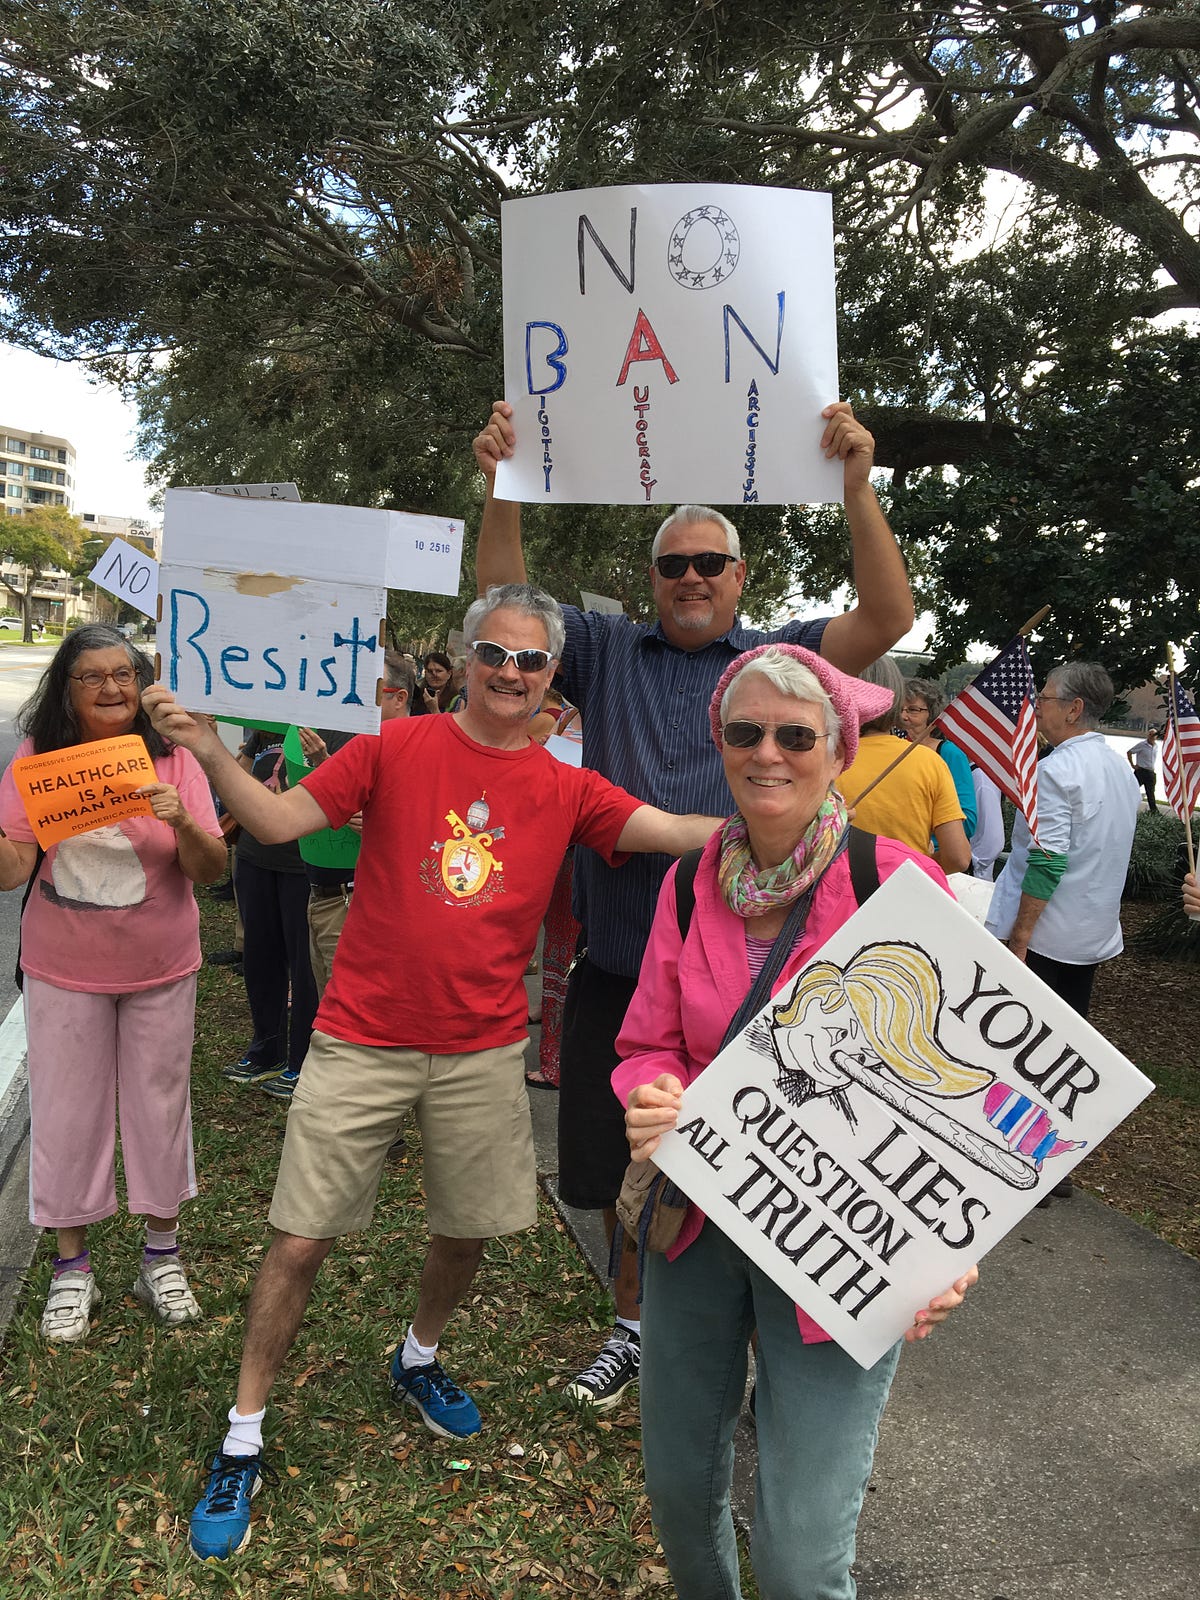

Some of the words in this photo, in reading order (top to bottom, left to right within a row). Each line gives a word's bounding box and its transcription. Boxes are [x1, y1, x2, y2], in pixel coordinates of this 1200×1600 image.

[577, 205, 741, 295] NO
[130, 529, 151, 537] DAY
[415, 540, 425, 551] 10
[103, 553, 151, 594] NO
[169, 588, 377, 706] Resist
[20, 757, 66, 772] PROGRESSIVE
[66, 748, 106, 762] DEMOCRATS
[29, 757, 149, 795] HEALTHCARE
[78, 789, 96, 803] IS
[102, 784, 115, 797] A
[37, 801, 105, 829] HUMAN
[949, 960, 1100, 1121] YOUR
[732, 1086, 915, 1266] QUESTION
[859, 1120, 992, 1250] LIES
[675, 1115, 732, 1172] ALL
[724, 1152, 891, 1321] TRUTH
